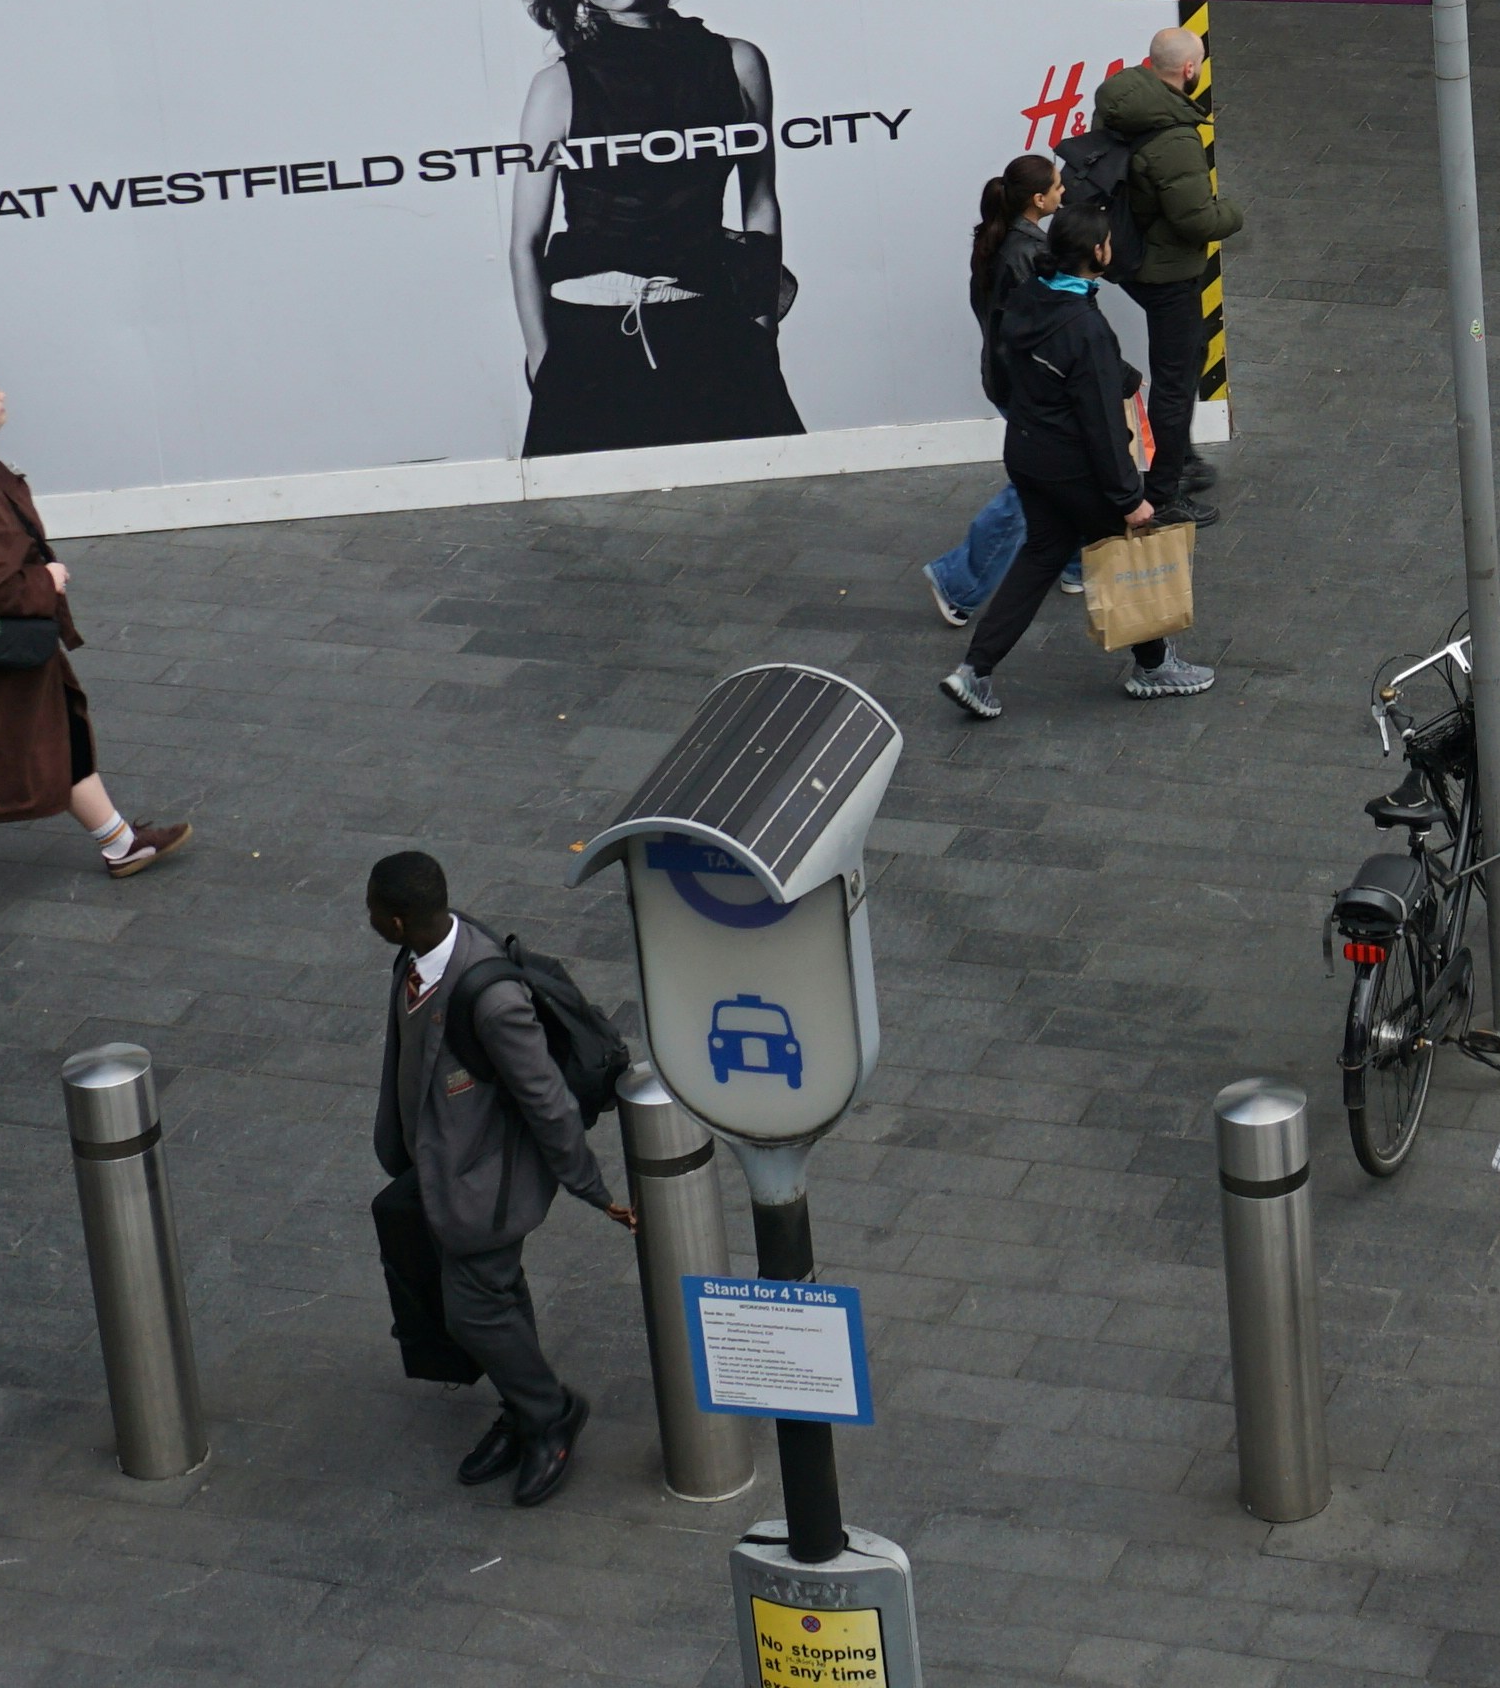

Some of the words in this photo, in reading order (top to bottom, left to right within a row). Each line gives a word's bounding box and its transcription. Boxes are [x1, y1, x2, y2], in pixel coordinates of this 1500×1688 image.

[69, 155, 406, 213] WESTFIELD
[418, 123, 768, 183] STRATFORD
[780, 108, 912, 150] CITY
[1115, 562, 1179, 584] PRIMARK
[703, 1281, 750, 1298] Stand
[753, 1285, 776, 1300] for
[780, 1287, 791, 1301] 4
[794, 1287, 838, 1304] Taxis
[761, 1632, 783, 1652] No
[791, 1643, 877, 1661] stopping
[765, 1657, 782, 1673] at
[790, 1664, 821, 1682] any
[831, 1667, 877, 1682] time
